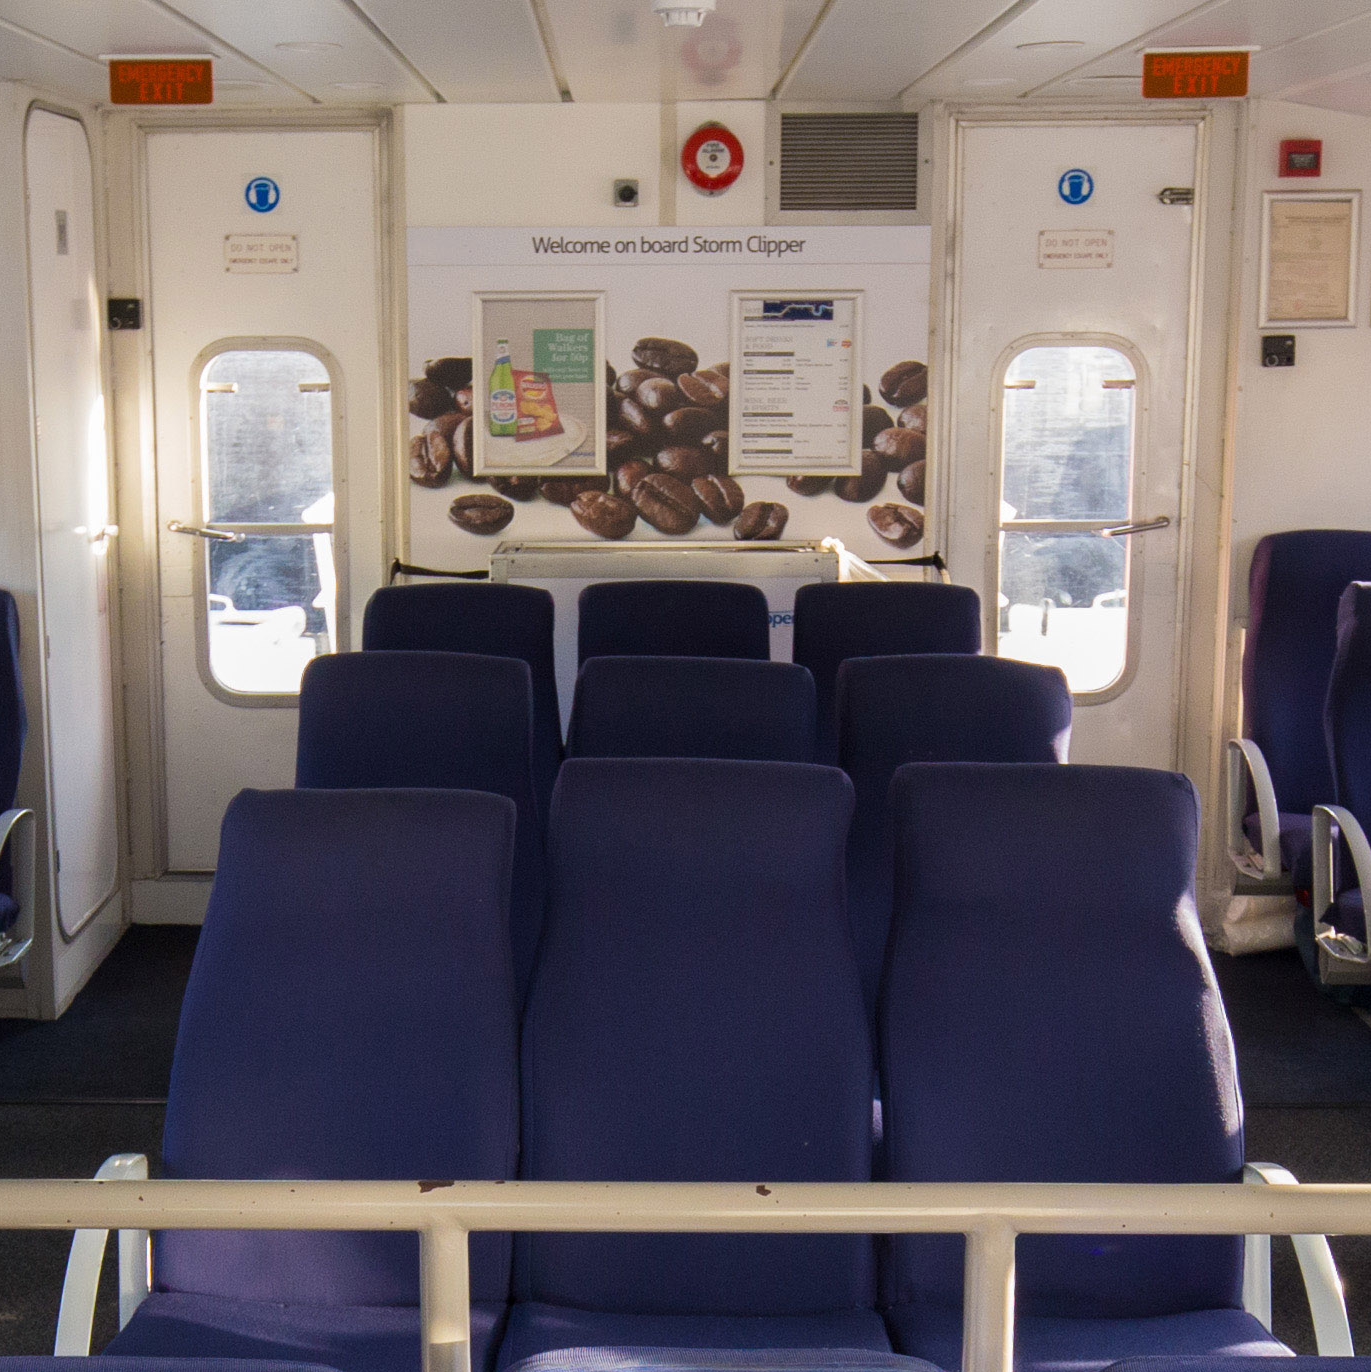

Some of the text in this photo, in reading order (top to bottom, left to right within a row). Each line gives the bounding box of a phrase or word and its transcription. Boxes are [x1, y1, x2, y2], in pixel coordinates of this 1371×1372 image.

[119, 64, 204, 82] EMERGENCY
[1153, 57, 1240, 76] EMERGENCY
[140, 83, 183, 101] EXIT
[1173, 76, 1220, 94] EXIT
[269, 243, 292, 252] OPEN
[532, 235, 806, 257] Welcome on board Storm Clipper
[1062, 238, 1079, 247] NOT
[1085, 238, 1107, 247] OPEN
